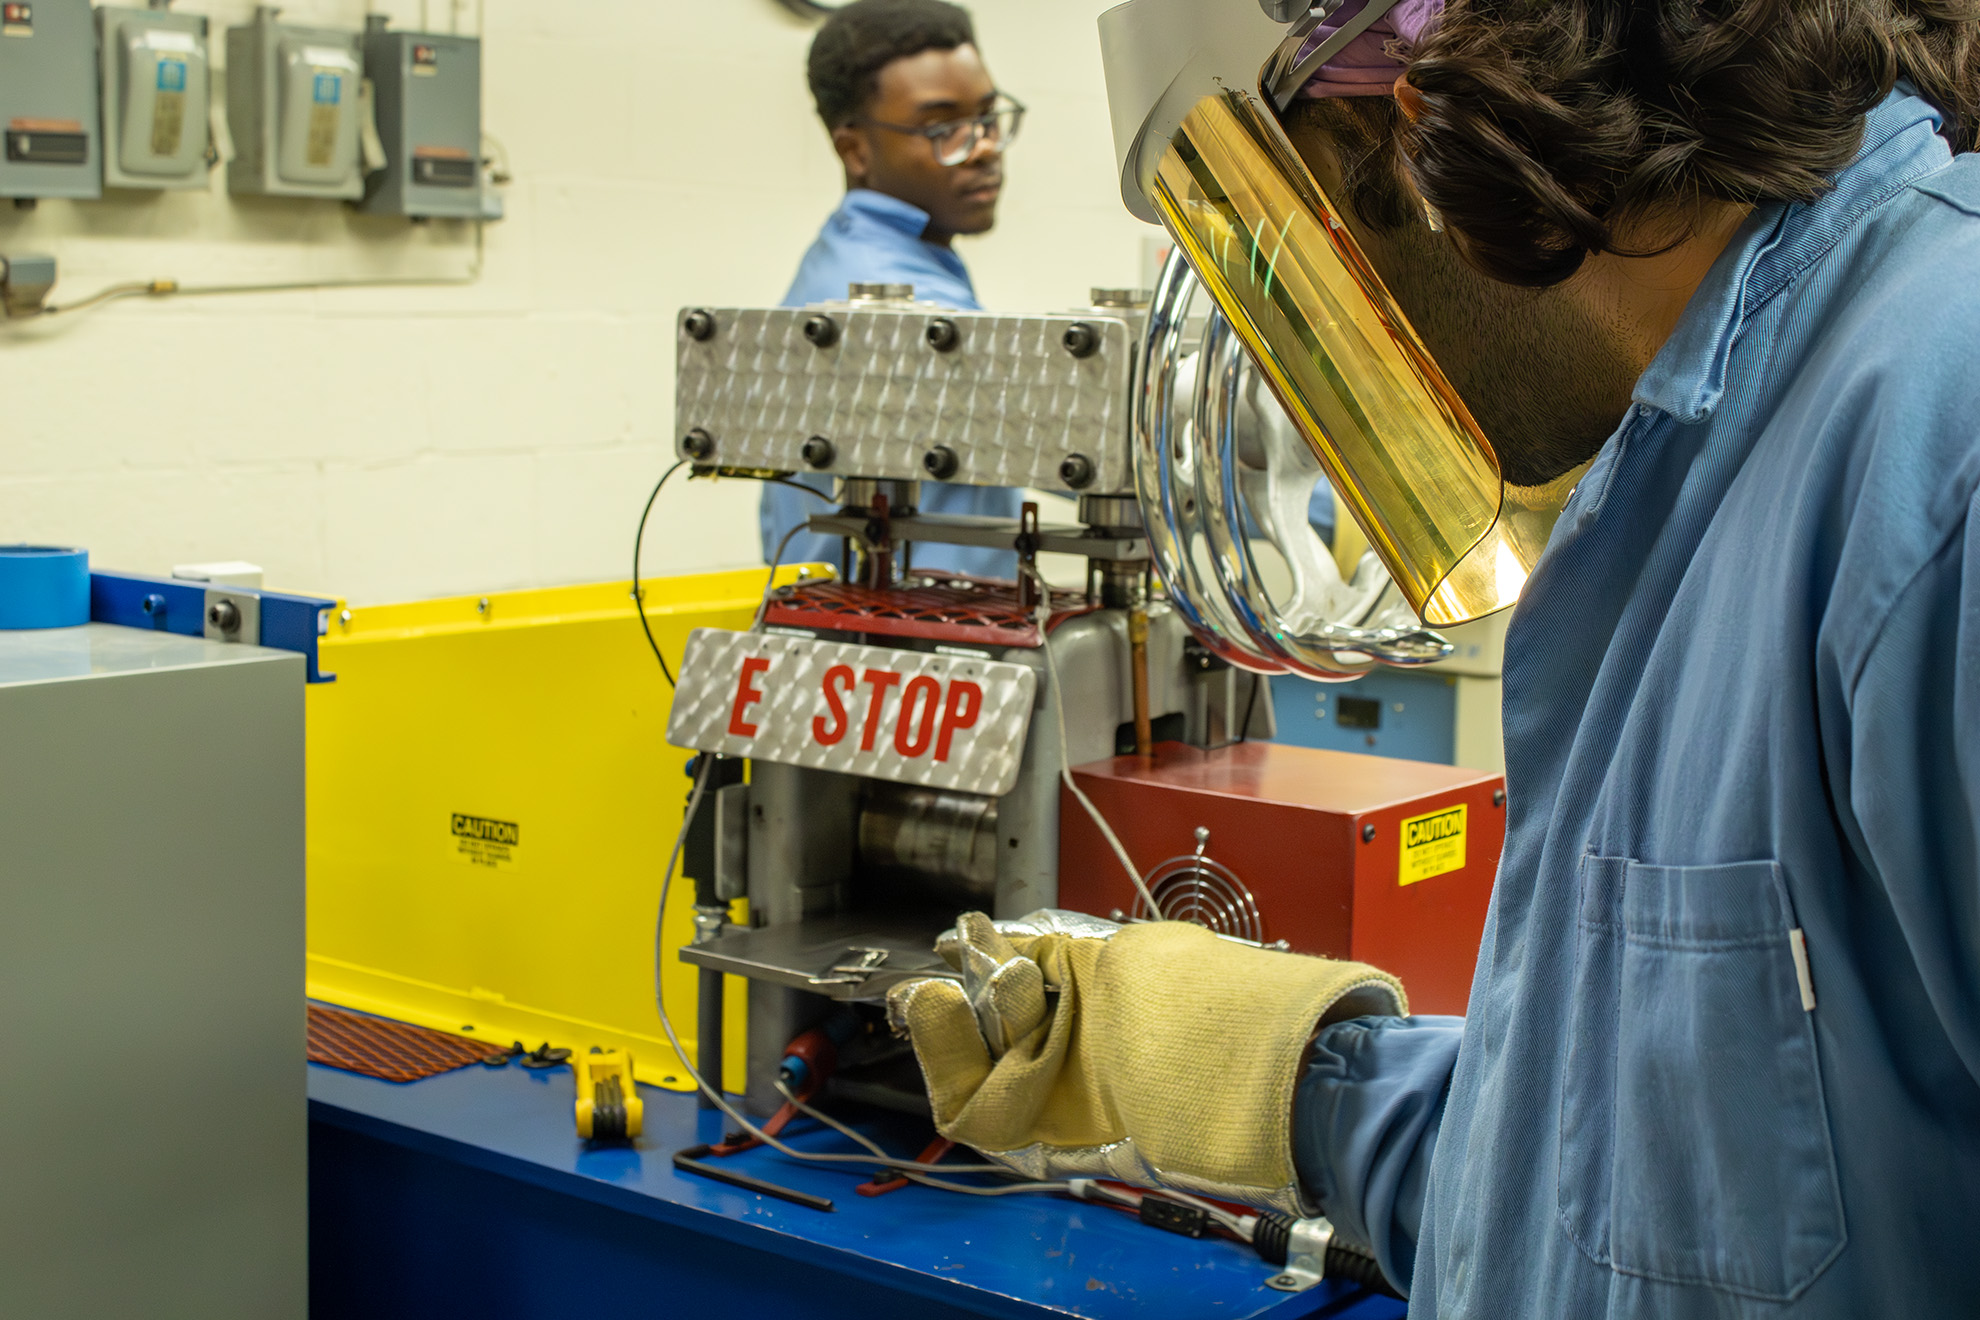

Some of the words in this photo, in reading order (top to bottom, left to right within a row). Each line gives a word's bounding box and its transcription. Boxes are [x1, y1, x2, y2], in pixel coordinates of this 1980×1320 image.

[728, 657, 770, 738] E
[812, 664, 983, 762] STOP
[453, 815, 517, 843] CAUTION
[1408, 811, 1462, 847] CAUTION
